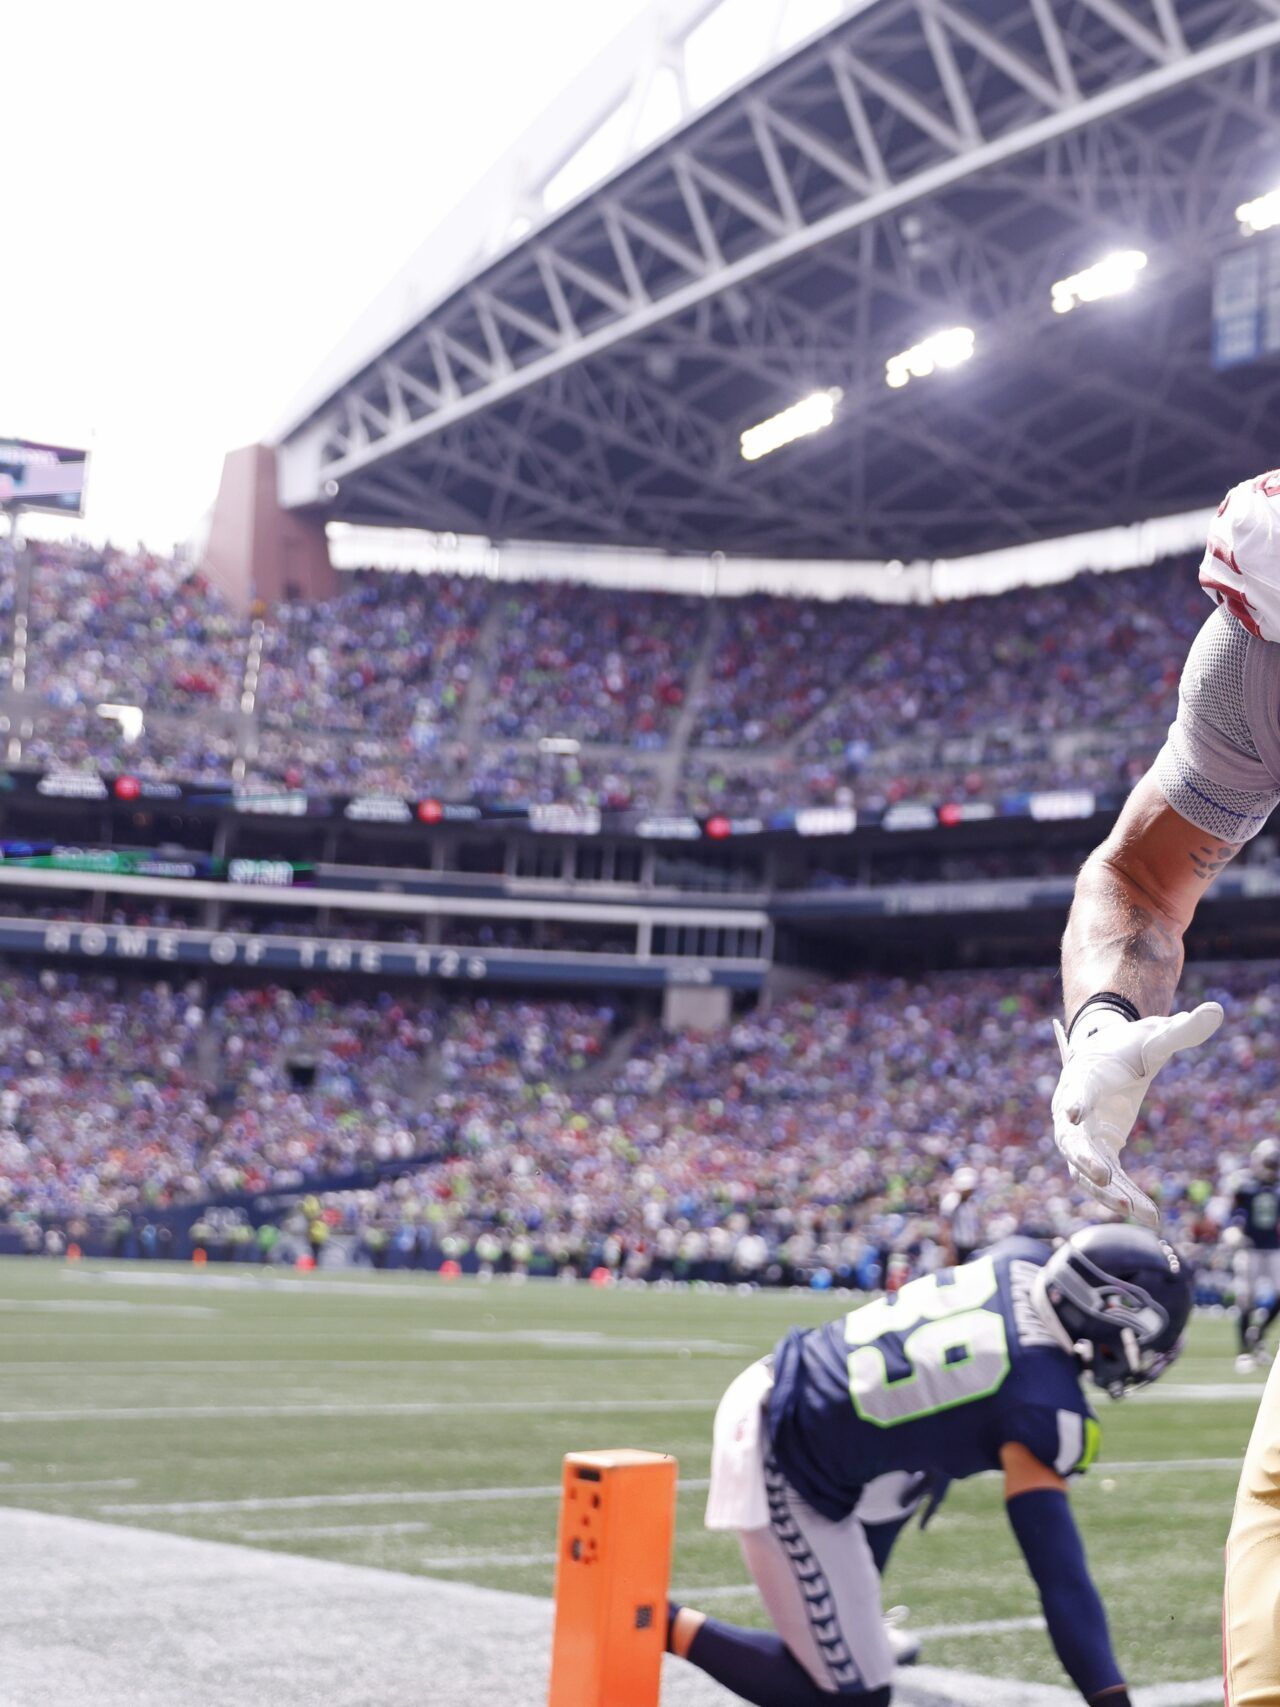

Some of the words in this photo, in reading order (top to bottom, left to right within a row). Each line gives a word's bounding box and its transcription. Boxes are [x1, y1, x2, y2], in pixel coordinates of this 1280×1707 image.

[45, 926, 179, 960] HOME
[210, 934, 267, 965] OF
[298, 940, 383, 974] THE
